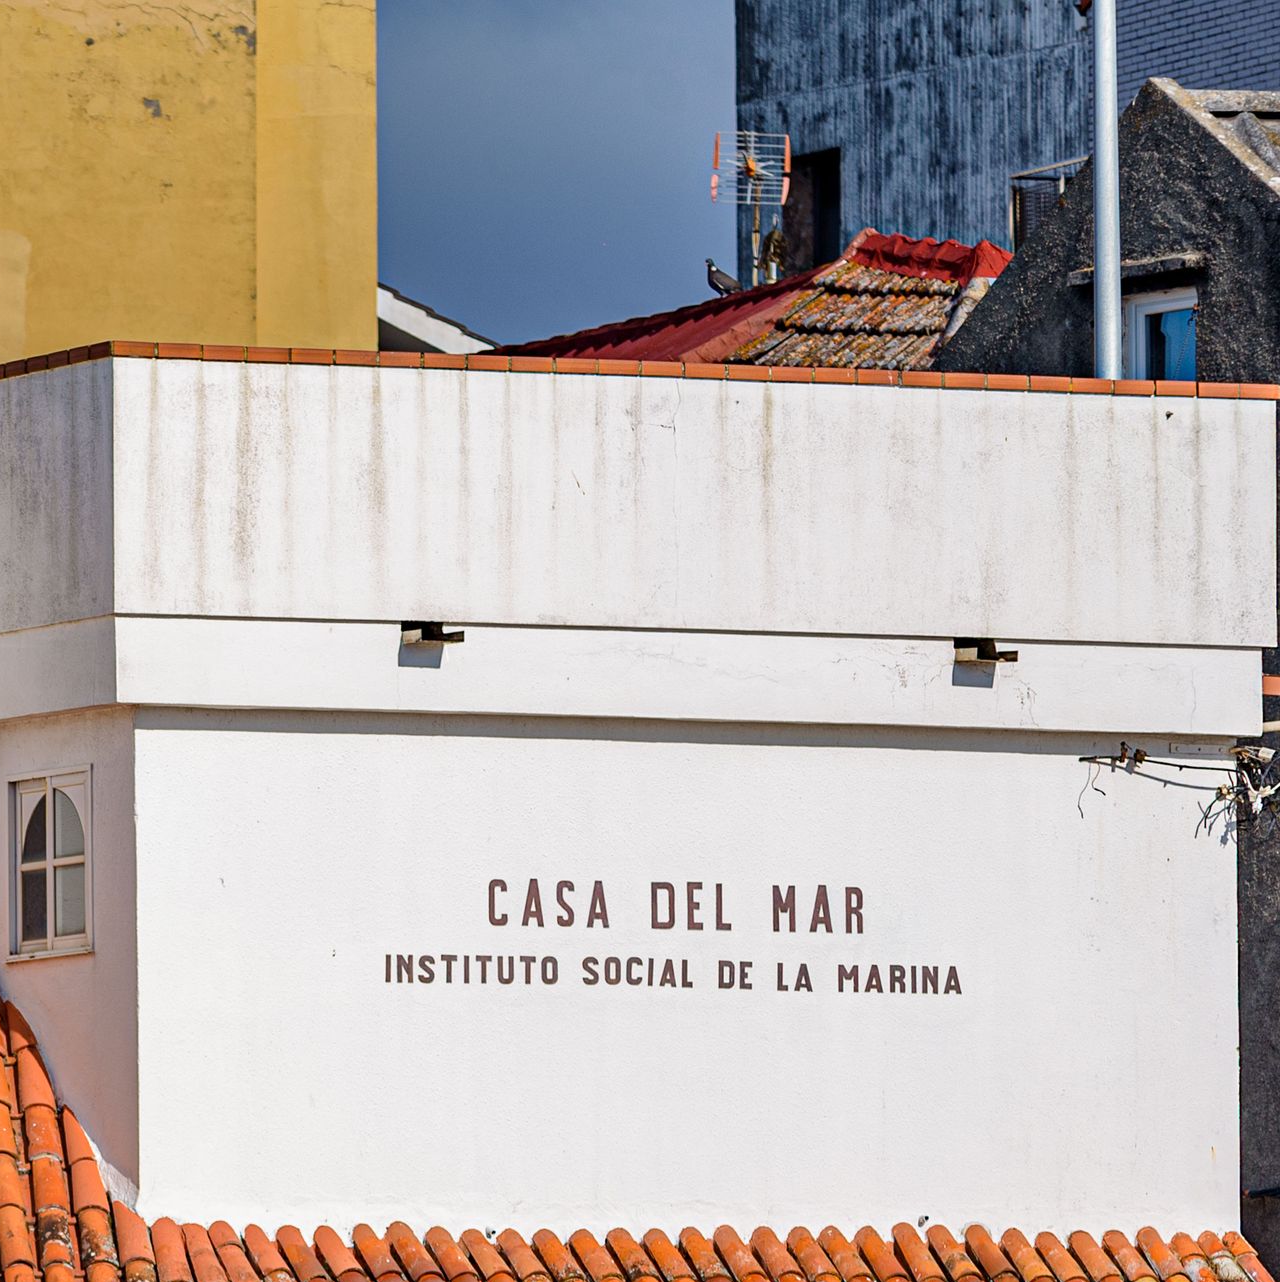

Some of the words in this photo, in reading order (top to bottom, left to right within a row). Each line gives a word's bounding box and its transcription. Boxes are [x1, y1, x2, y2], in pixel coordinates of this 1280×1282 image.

[488, 878, 610, 929] CASA
[650, 881, 732, 931] DEL
[772, 884, 864, 935] MAR
[384, 954, 559, 985] INSTITUTO
[581, 956, 694, 989] SOCIAL
[718, 959, 753, 990] DE
[776, 962, 813, 993] LA
[837, 964, 963, 995] MARINA
